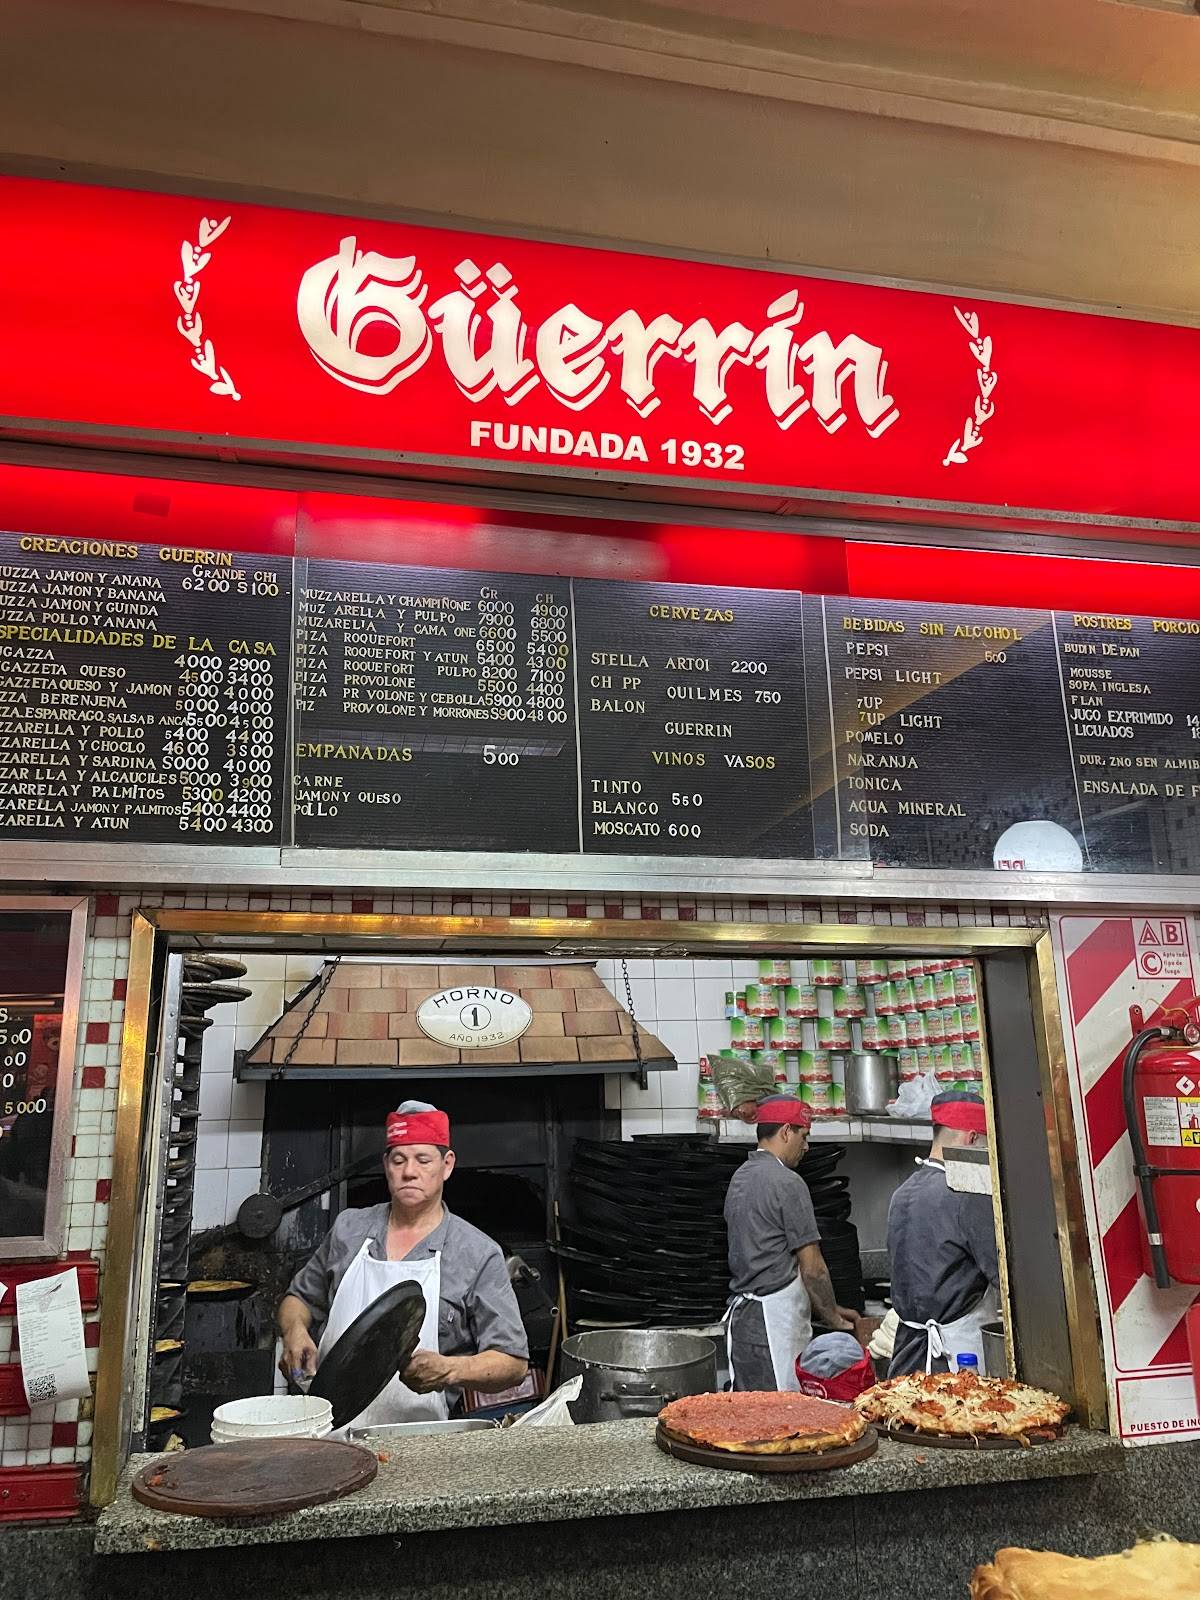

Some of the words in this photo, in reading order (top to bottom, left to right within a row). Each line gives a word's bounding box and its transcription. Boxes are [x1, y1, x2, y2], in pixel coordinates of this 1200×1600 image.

[470, 420, 649, 462] FUNDADA
[661, 439, 745, 471] 1932
[20, 537, 138, 558] CREACIONES
[159, 548, 232, 566] GUERRIN
[192, 565, 246, 580] GRANDE
[46, 570, 93, 583] JAMON
[111, 575, 161, 588] ANANA
[182, 577, 230, 593] 6200
[42, 584, 92, 596] JAMON
[108, 588, 166, 602] BANANA
[536, 594, 554, 603] CH
[41, 599, 91, 611] JAMON
[106, 602, 158, 616] GUINDA
[300, 588, 385, 604] MUZZARELLA
[478, 600, 514, 614] 6000
[531, 604, 568, 618] 4900
[42, 612, 89, 625] POLLO
[103, 617, 157, 631] ANANA
[415, 611, 455, 623] PULPO
[478, 613, 514, 626] 7900
[531, 617, 565, 630] 6800
[650, 605, 734, 622] CERVEZAS
[1073, 614, 1132, 630] POSTRES
[480, 627, 516, 640] 6600
[531, 630, 566, 643] 5500
[843, 616, 906, 633] BEBIDAS
[919, 622, 944, 636] SIN
[953, 625, 1022, 641] ALCOHOL
[152, 634, 177, 649] DE
[188, 637, 214, 652] LA
[229, 640, 276, 656] CASA
[296, 629, 328, 642] PIZA
[344, 633, 416, 647] ROQUEFORT
[476, 640, 515, 653] 6500
[527, 642, 569, 656] 5400
[845, 641, 889, 657] PEPSI
[1064, 643, 1096, 654] BUDIN
[1102, 643, 1118, 656] DE
[1120, 647, 1140, 658] PAN
[174, 654, 222, 670] 4000
[228, 657, 271, 673] 2900
[296, 644, 328, 655] PIZA
[344, 646, 416, 661] ROQUEFORT
[435, 653, 468, 664] ATUN
[478, 653, 514, 666] 5400
[526, 657, 566, 670] 4300
[591, 653, 649, 668] STELLA
[731, 661, 768, 675] 2200
[80, 664, 126, 678] QUESO
[179, 669, 224, 684] 4500
[227, 671, 273, 687] 3400
[296, 658, 327, 669] PIZA
[344, 660, 414, 674] ROQUEFORT
[437, 666, 476, 677] PULPO
[482, 666, 517, 680] 8200
[531, 669, 565, 683] 7100
[845, 667, 882, 681] PEPSI
[895, 670, 942, 685] LIGHT
[1070, 668, 1112, 679] MOUSSE
[60, 679, 101, 692] QUESO
[126, 683, 172, 696] JAMON
[178, 683, 219, 698] 5000
[224, 686, 274, 701] 4000
[296, 671, 327, 683] PIZA
[344, 675, 415, 688] PROVOLONE
[478, 679, 517, 694] 5500
[526, 683, 563, 696] 4400
[591, 676, 612, 689] CH
[622, 677, 642, 690] PP
[1069, 680, 1097, 692] SOPA
[1102, 682, 1151, 694] INGLESA
[40, 692, 128, 709] BERENJENA
[175, 699, 219, 713] 5000
[227, 700, 272, 715] 4000
[294, 683, 327, 697] PIZA
[526, 696, 564, 709] 4800
[667, 686, 743, 702] QUILMES
[754, 691, 781, 704] 750
[856, 697, 883, 710] 7UP
[1071, 695, 1103, 706] FLAN
[343, 702, 415, 716] PROVOLONE
[433, 707, 489, 719] MORRONES
[527, 710, 567, 723] 4800
[590, 699, 645, 714] BALON
[229, 715, 274, 730] 4500
[859, 711, 886, 726] 7UP
[900, 713, 942, 729] LIGHT
[1070, 709, 1101, 721] JUGO
[1108, 710, 1173, 725] EXPRIMIDO
[100, 726, 144, 739] POLLO
[165, 727, 208, 741] 5400
[226, 730, 273, 744] 4400
[665, 722, 732, 738] GUERRIN
[845, 730, 904, 746] POMELO
[1074, 724, 1134, 738] LICUADOS
[91, 740, 145, 754] CHOCLO
[162, 741, 209, 756] 4600
[296, 744, 413, 762] EMPANADAS
[483, 745, 519, 766] 500
[92, 756, 157, 770] SARDINA
[223, 759, 271, 773] 4000
[652, 751, 705, 766] VINOS
[724, 754, 776, 769] VASOS
[848, 754, 918, 769] NARANJA
[89, 771, 177, 784] ALCAUCILES
[180, 771, 221, 786] 5000
[230, 774, 272, 788] 3900
[294, 775, 344, 788] CARNE
[591, 779, 642, 795] TINTO
[848, 777, 902, 792] TONICA
[92, 785, 164, 799] PALMITOS
[182, 787, 223, 802] 5300
[228, 788, 271, 803] 4200
[295, 790, 340, 802] JAMON
[358, 792, 401, 804] QUESO
[1083, 781, 1158, 796] ENSALADA
[1165, 784, 1184, 797] DE
[591, 800, 659, 815] BLANCO
[671, 793, 703, 807] 550
[849, 800, 888, 814] AGUA
[897, 801, 966, 817] MINERAL
[71, 803, 110, 813] JAMON
[125, 804, 181, 815] PALMITOS
[182, 802, 224, 816] 5400
[226, 804, 271, 817] 4400
[294, 803, 337, 816] POLLO
[91, 817, 129, 829] ATUN
[179, 817, 227, 832] 5400
[231, 819, 273, 833] 4300
[593, 821, 660, 836] MOSCATO
[668, 824, 702, 839] 600
[850, 823, 889, 837] SODA
[1165, 924, 1178, 942] B
[433, 988, 514, 1008] HORNO
[471, 1007, 480, 1026] 1
[449, 1033, 473, 1043] AÑO
[477, 1031, 505, 1044] 1932
[5, 1099, 46, 1114] 5000
[1130, 1421, 1169, 1432] PUESTO
[1172, 1419, 1185, 1428] DE
